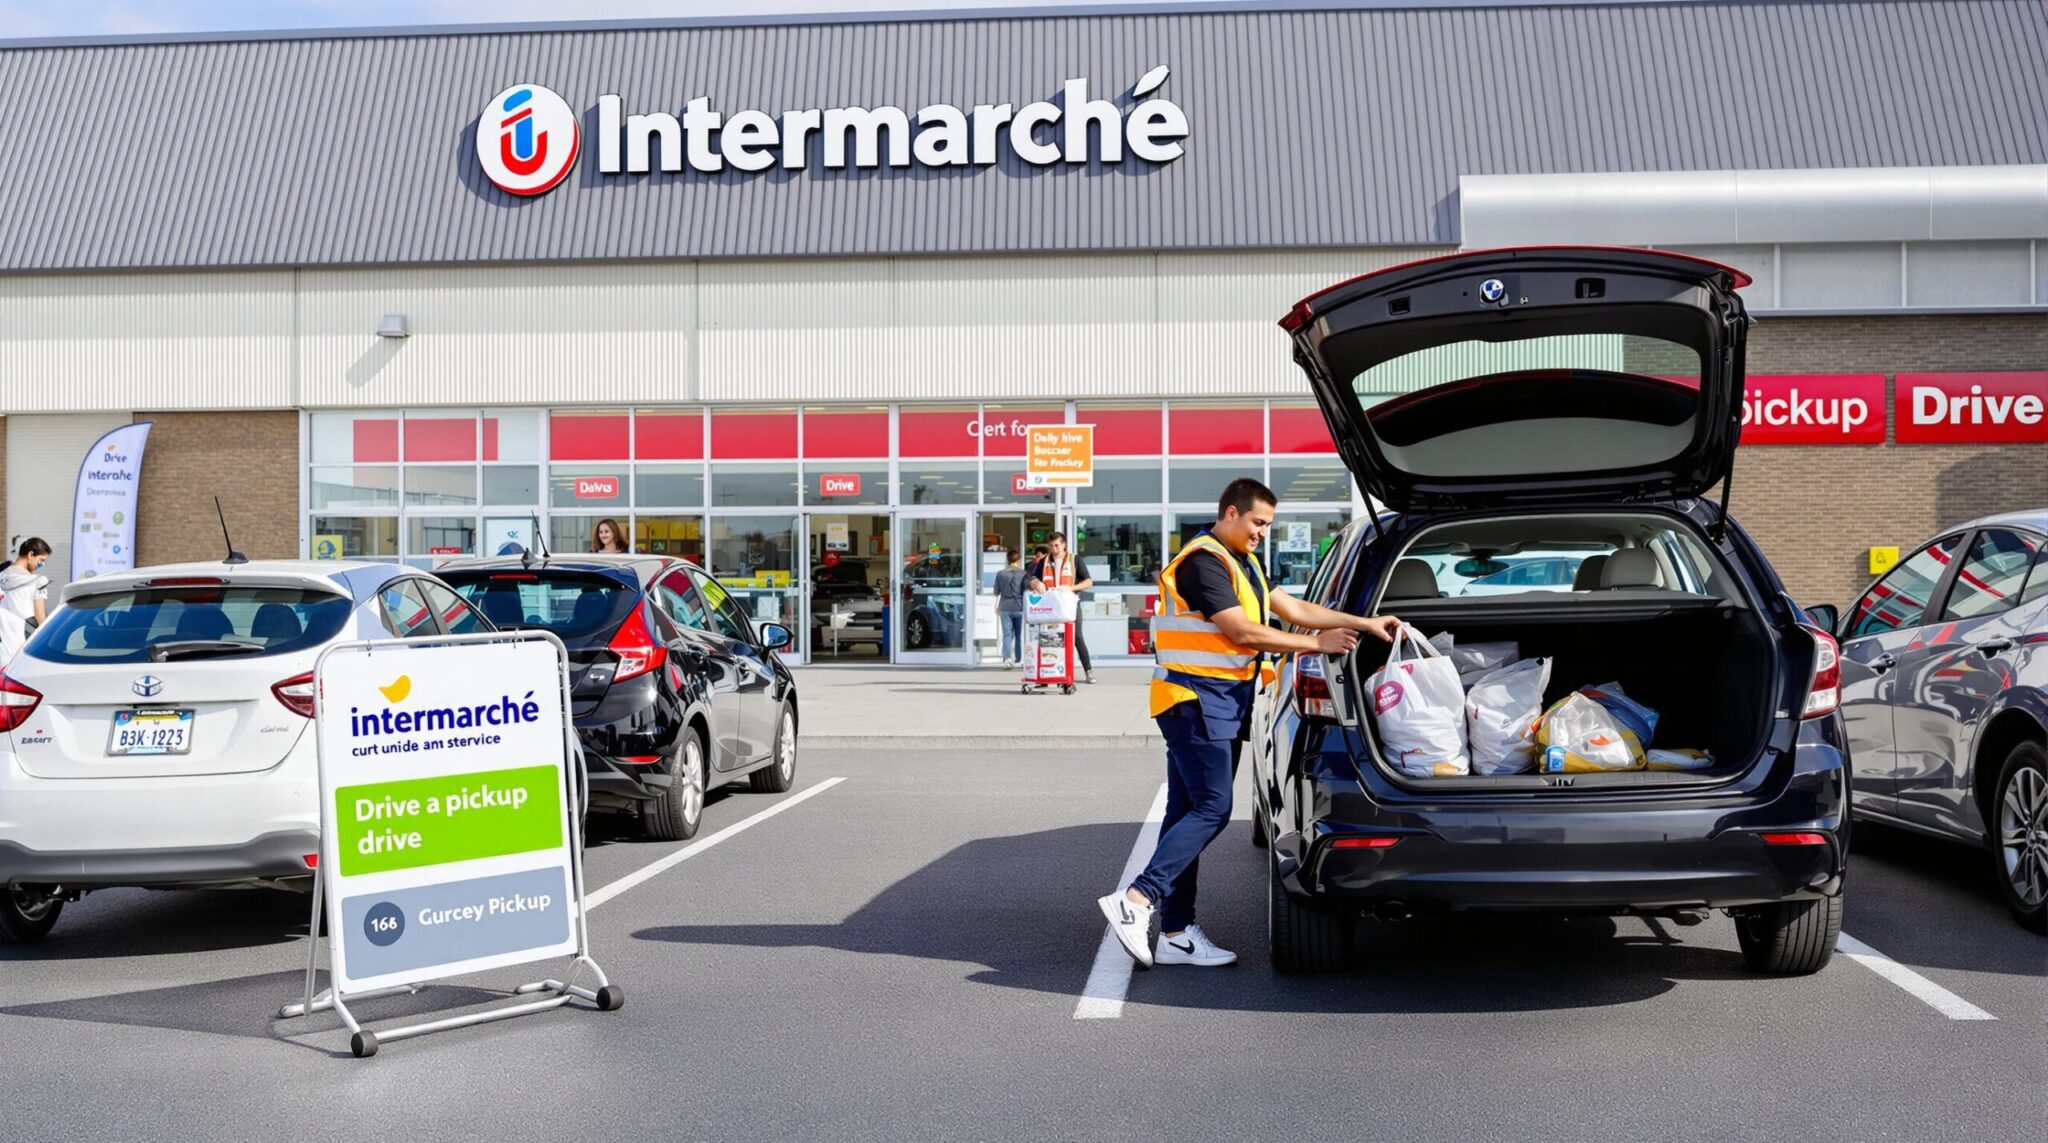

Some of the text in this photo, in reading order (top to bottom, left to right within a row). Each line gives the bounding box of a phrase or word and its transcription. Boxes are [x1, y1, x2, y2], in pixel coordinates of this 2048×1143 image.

[599, 64, 1190, 173] Intermarché
[1912, 384, 2044, 425] Drive
[826, 479, 855, 492] Drive
[351, 690, 540, 737] intermarché
[351, 743, 379, 757] curt
[381, 739, 419, 754] unide
[447, 733, 501, 749] stervice
[355, 784, 528, 822] Drive a pickup
[358, 828, 422, 855] drive
[418, 893, 552, 926] Gurcey Pickup
